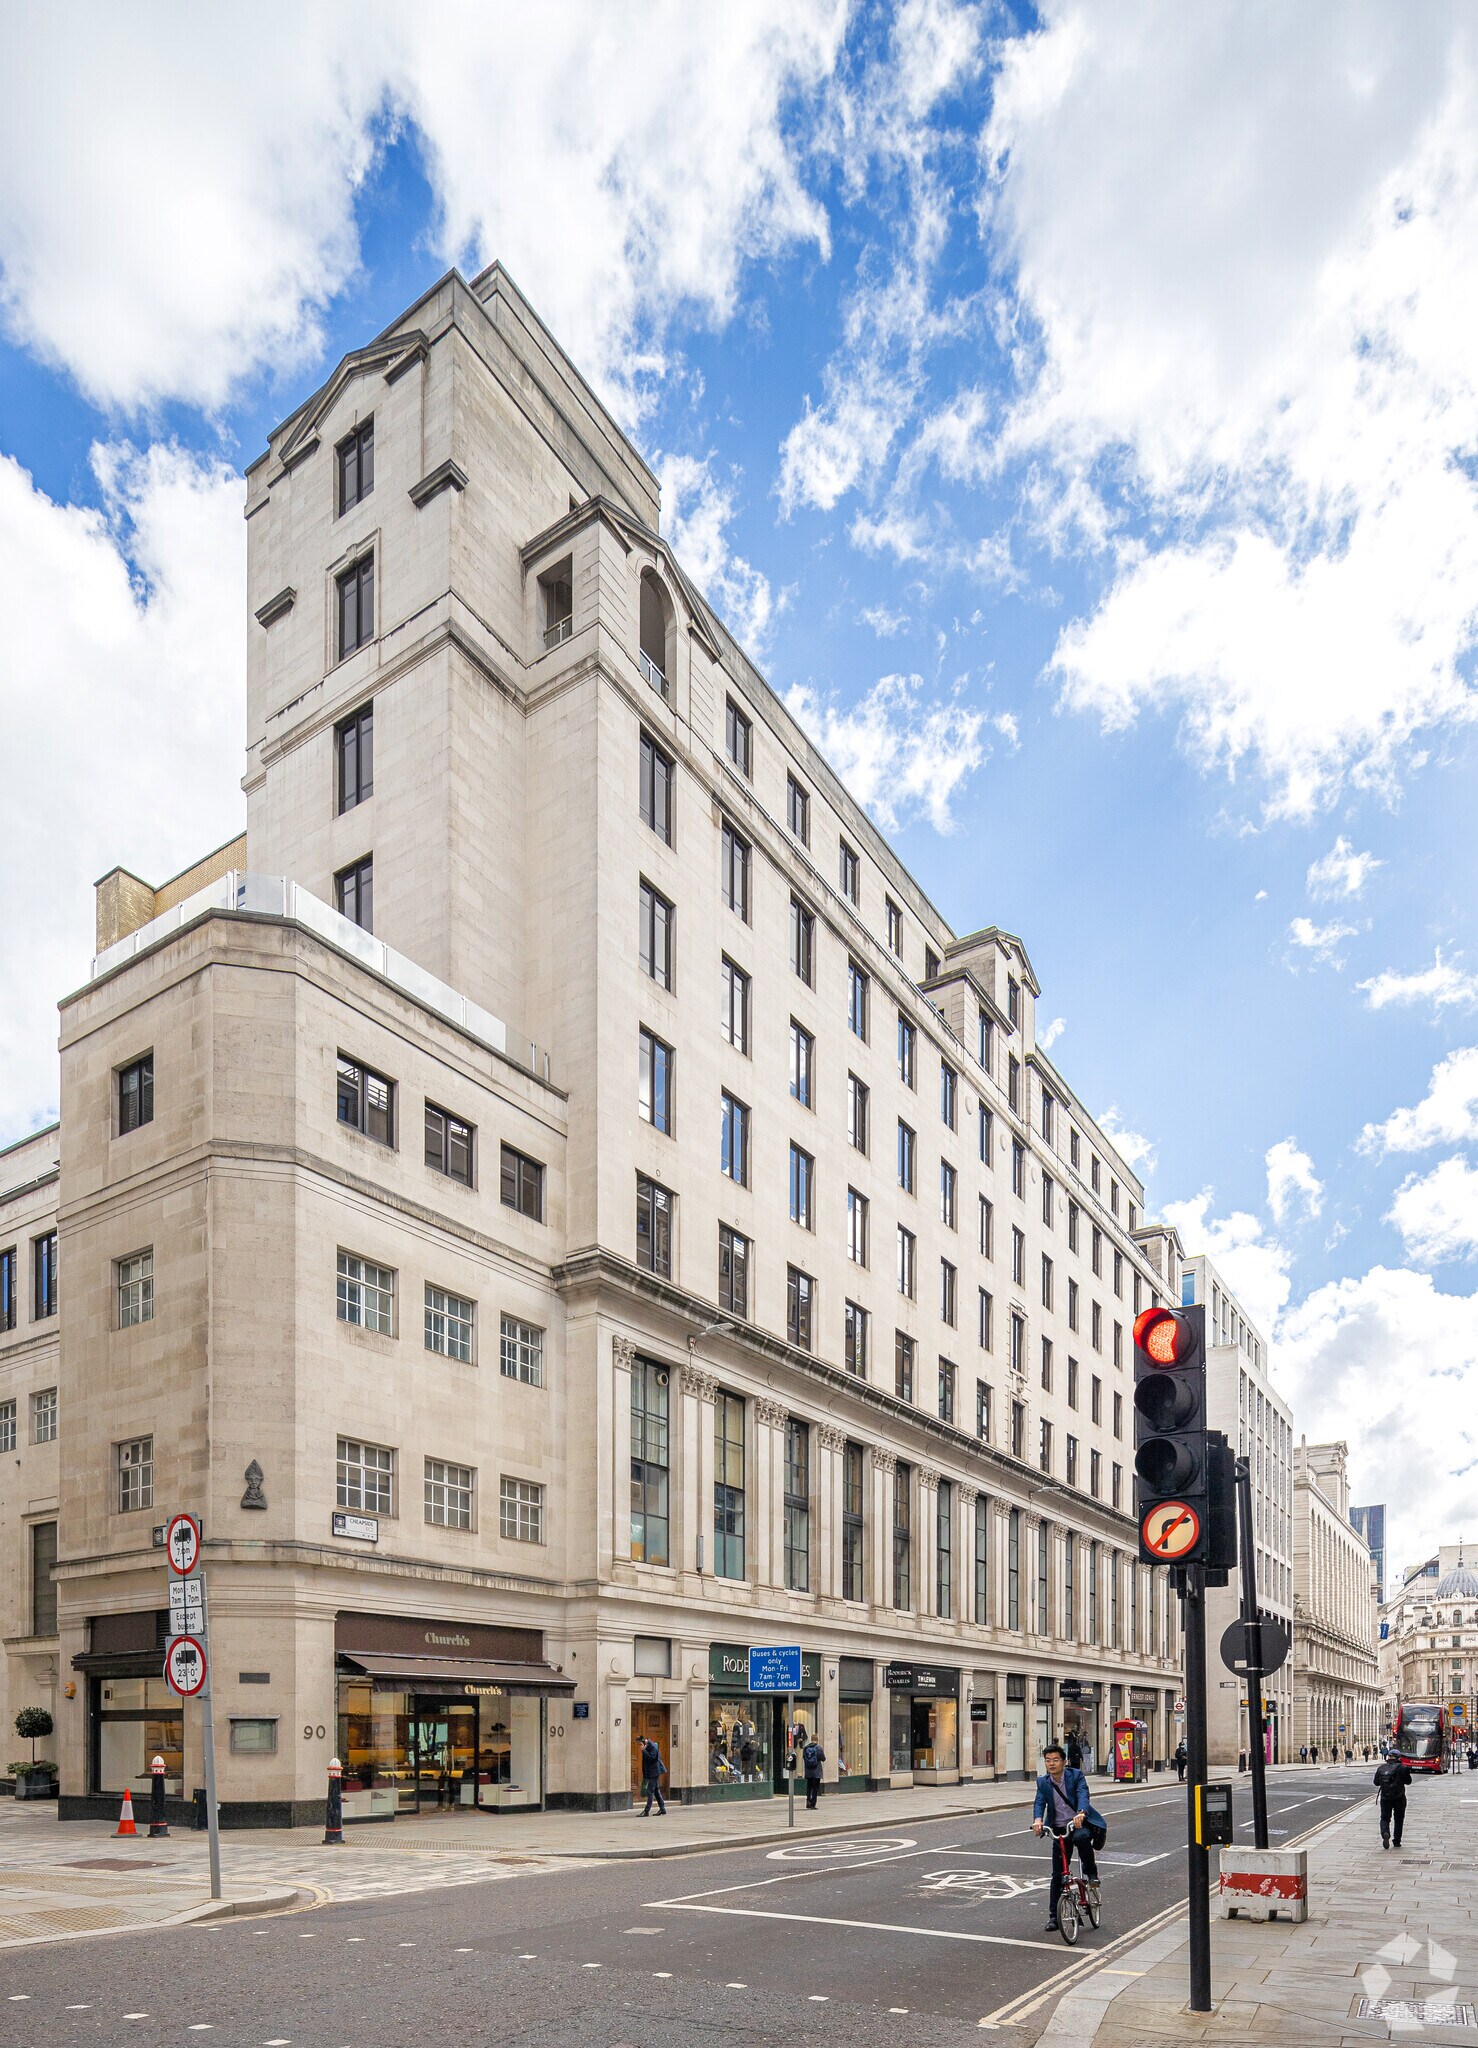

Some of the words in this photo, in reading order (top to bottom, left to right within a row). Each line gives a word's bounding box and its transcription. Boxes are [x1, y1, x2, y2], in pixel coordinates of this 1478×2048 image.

[350, 1518, 374, 1527] CHEAPSIDE
[172, 1586, 183, 1595] Mon
[190, 1583, 198, 1593] Fri
[171, 1596, 182, 1605] 7am
[187, 1594, 200, 1604] 7pm
[424, 1631, 471, 1647] Church's
[779, 1649, 798, 1657] cycles
[767, 1657, 782, 1665] only
[464, 1683, 503, 1696] Church's
[1131, 1692, 1144, 1701] ERNEST
[303, 1724, 326, 1740] 90
[549, 1725, 565, 1738] 90
